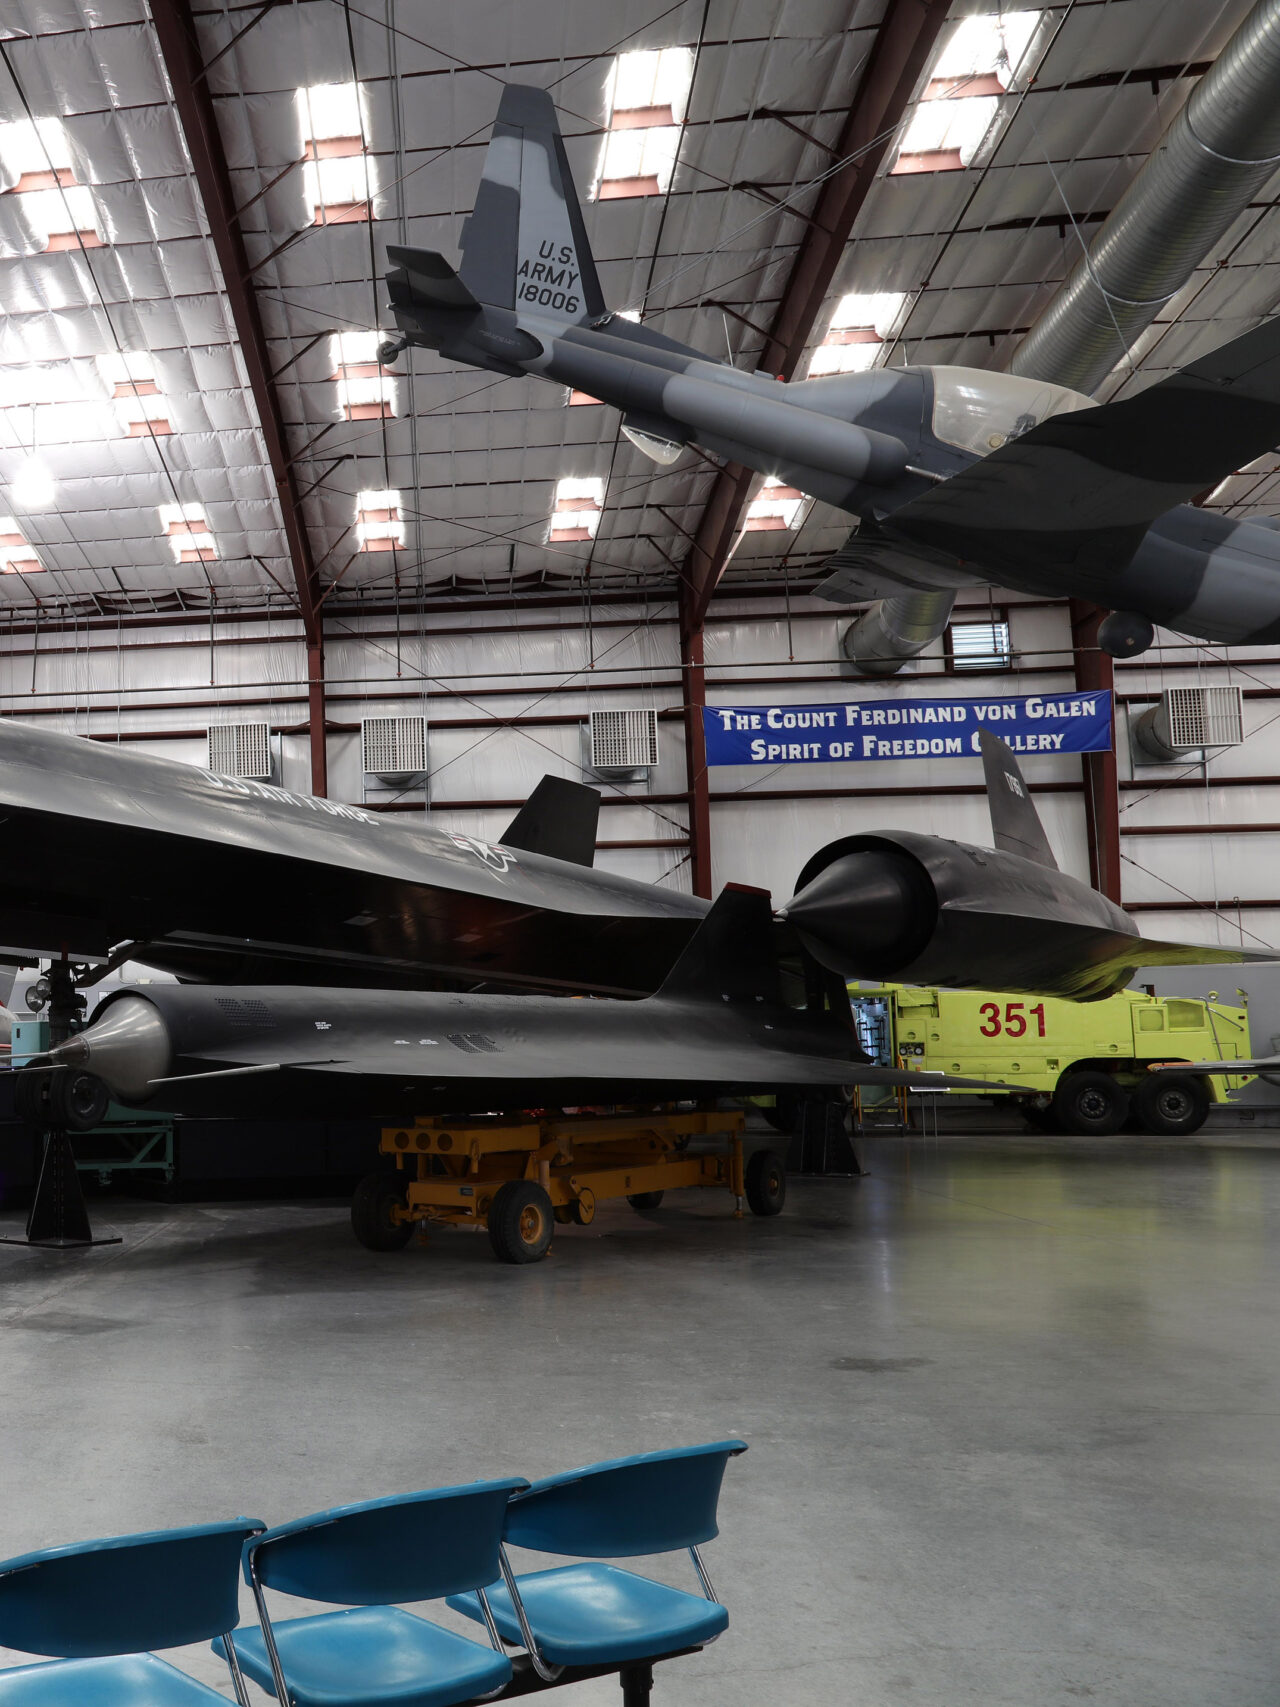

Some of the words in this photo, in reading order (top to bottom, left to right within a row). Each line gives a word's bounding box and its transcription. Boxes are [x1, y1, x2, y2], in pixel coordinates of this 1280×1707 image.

[539, 240, 575, 267] U.S.
[517, 260, 579, 289] ARMY
[518, 282, 580, 313] 18006
[252, 781, 303, 808] AIR
[296, 792, 381, 826] FORCE
[979, 1002, 1046, 1038] 351
